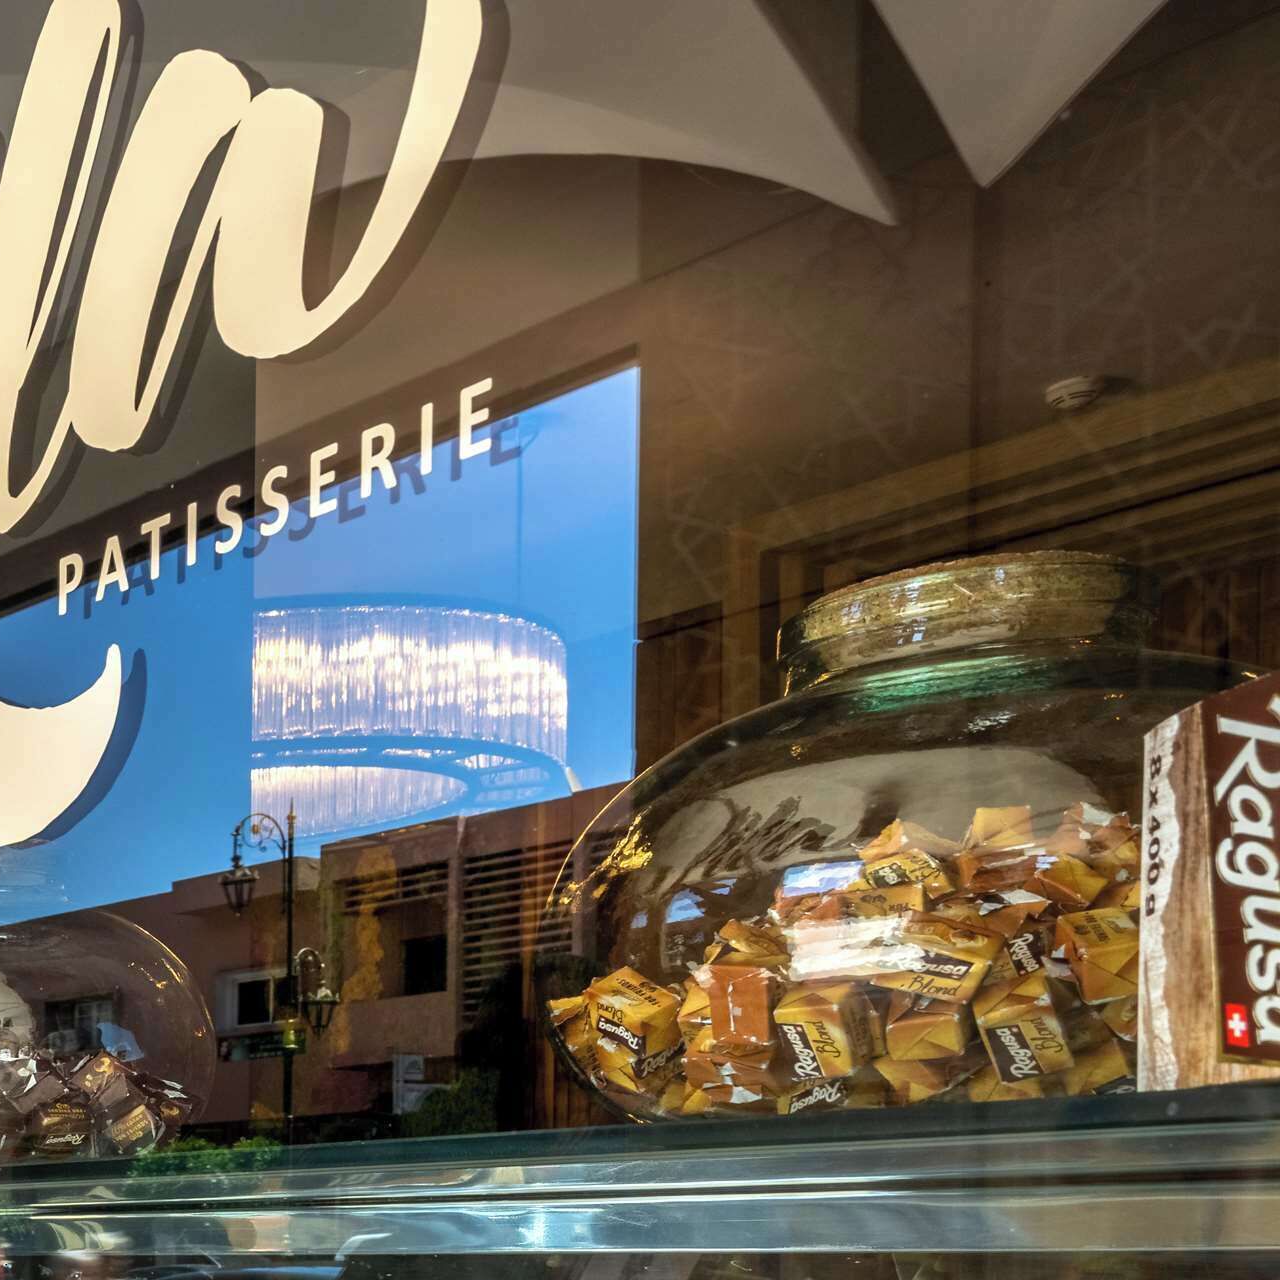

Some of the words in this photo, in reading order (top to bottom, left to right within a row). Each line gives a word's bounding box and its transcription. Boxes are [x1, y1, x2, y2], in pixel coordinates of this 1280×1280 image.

[56, 376, 495, 617] PATISSERIE
[1148, 753, 1163, 781] 8
[1146, 821, 1163, 887] 400
[1009, 933, 1040, 973] Ragusa
[907, 974, 963, 997] Blond
[598, 1020, 640, 1050] Ragusa
[785, 1024, 819, 1078] Ragusa
[814, 1020, 840, 1058] Blond
[996, 1027, 1040, 1079] Ragusa
[1021, 1015, 1064, 1054] Blond
[790, 1081, 842, 1114] Ragusa
